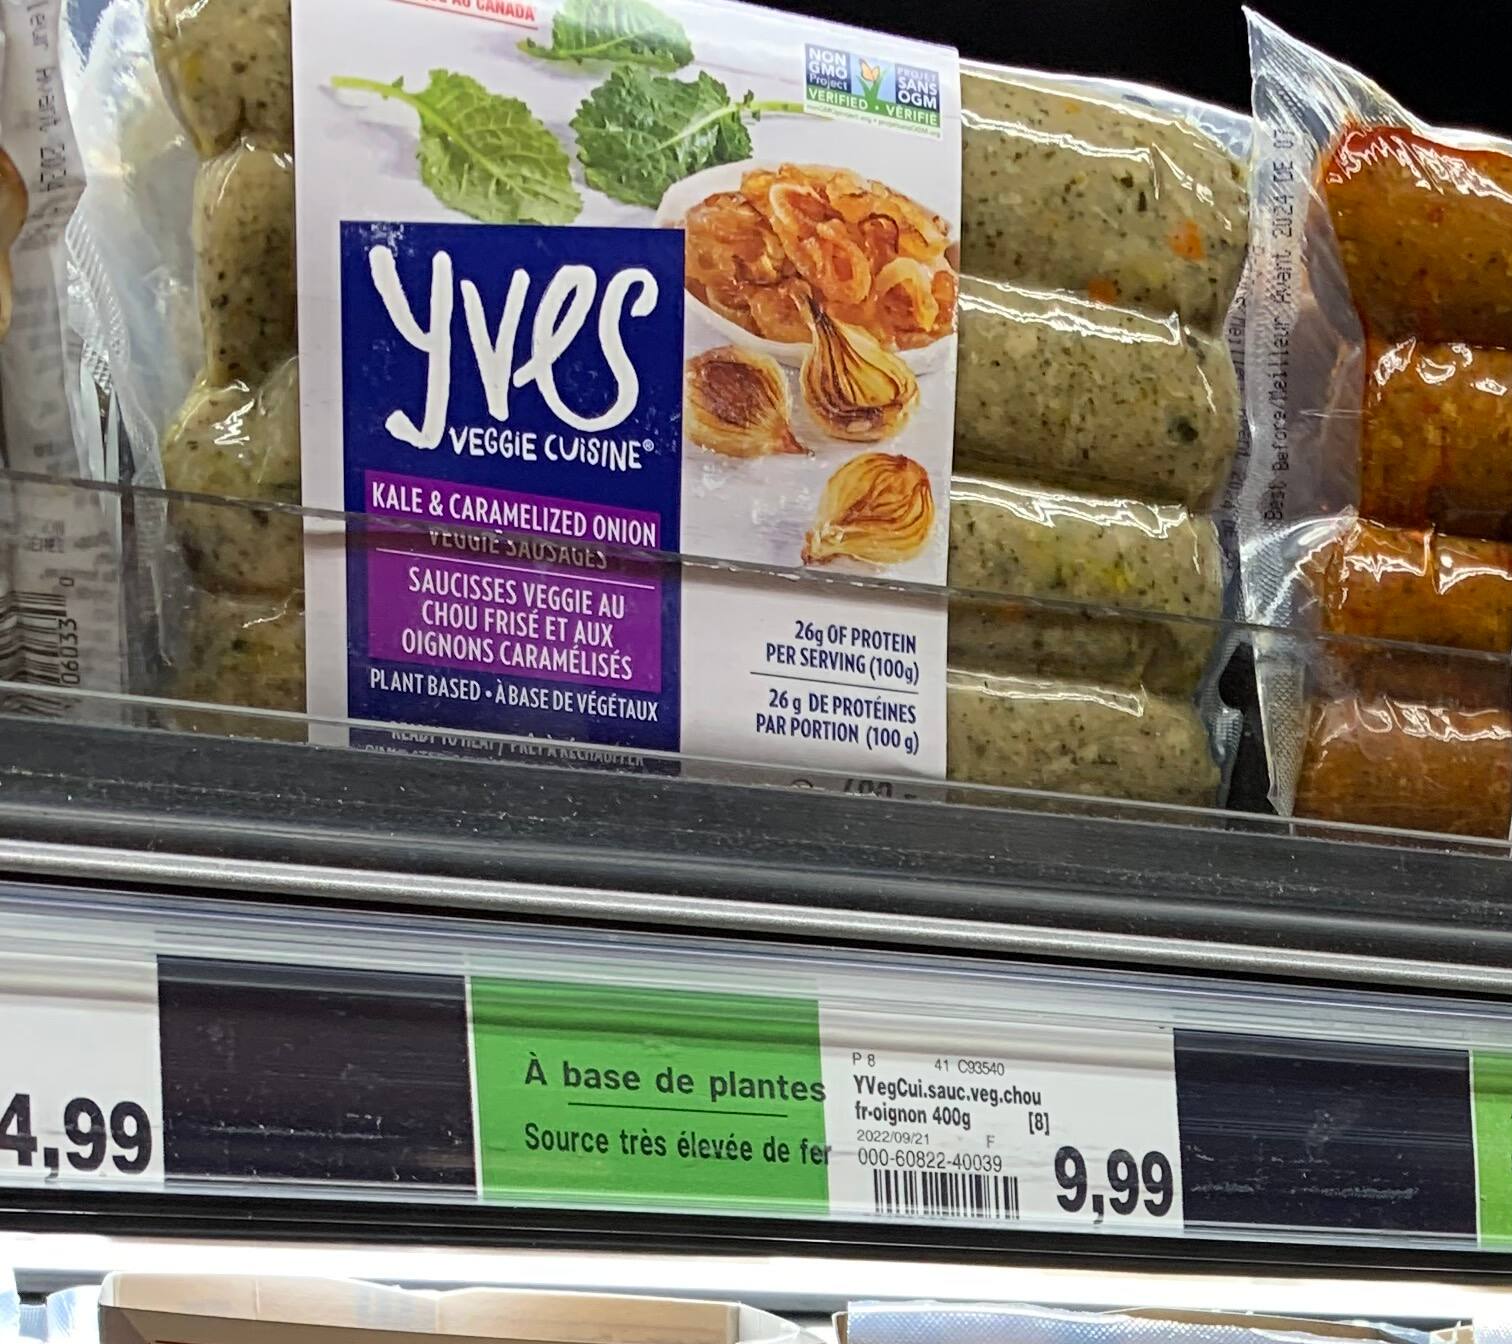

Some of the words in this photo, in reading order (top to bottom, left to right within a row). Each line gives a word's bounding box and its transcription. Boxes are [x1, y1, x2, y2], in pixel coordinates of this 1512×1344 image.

[372, 482, 423, 513] KALE
[429, 491, 443, 516] &
[451, 494, 587, 536] CARAMELIZED
[592, 515, 657, 547] ONION
[408, 566, 517, 604] SAUCISSES
[522, 580, 593, 612] VEGGIE
[599, 594, 625, 618] AU
[422, 601, 477, 630] CHOU
[483, 604, 540, 638] FRISÉ
[545, 619, 567, 641] ET
[574, 623, 613, 648] AUX
[794, 621, 824, 648] 26g
[828, 624, 847, 647] OF
[851, 626, 917, 653] PROTEIN
[402, 629, 493, 665] OIGNONS
[500, 636, 632, 680] CARAMÉLISÉS
[524, 1051, 547, 1086] À
[562, 1060, 641, 1091] base
[655, 1066, 694, 1095] de
[709, 1071, 827, 1104] plantes
[0, 1093, 152, 1182] 4,99
[524, 1122, 609, 1153] Source
[620, 1128, 667, 1157] très
[677, 1131, 753, 1161] élevée
[763, 1136, 790, 1164] de
[800, 1138, 832, 1167] fer
[856, 1129, 930, 1146] 2022/09/21
[932, 1106, 971, 1130] 400g
[1028, 1111, 1050, 1136] [8]
[858, 1148, 1003, 1173] 000-60822-40039
[1054, 1145, 1174, 1224] 9,99
